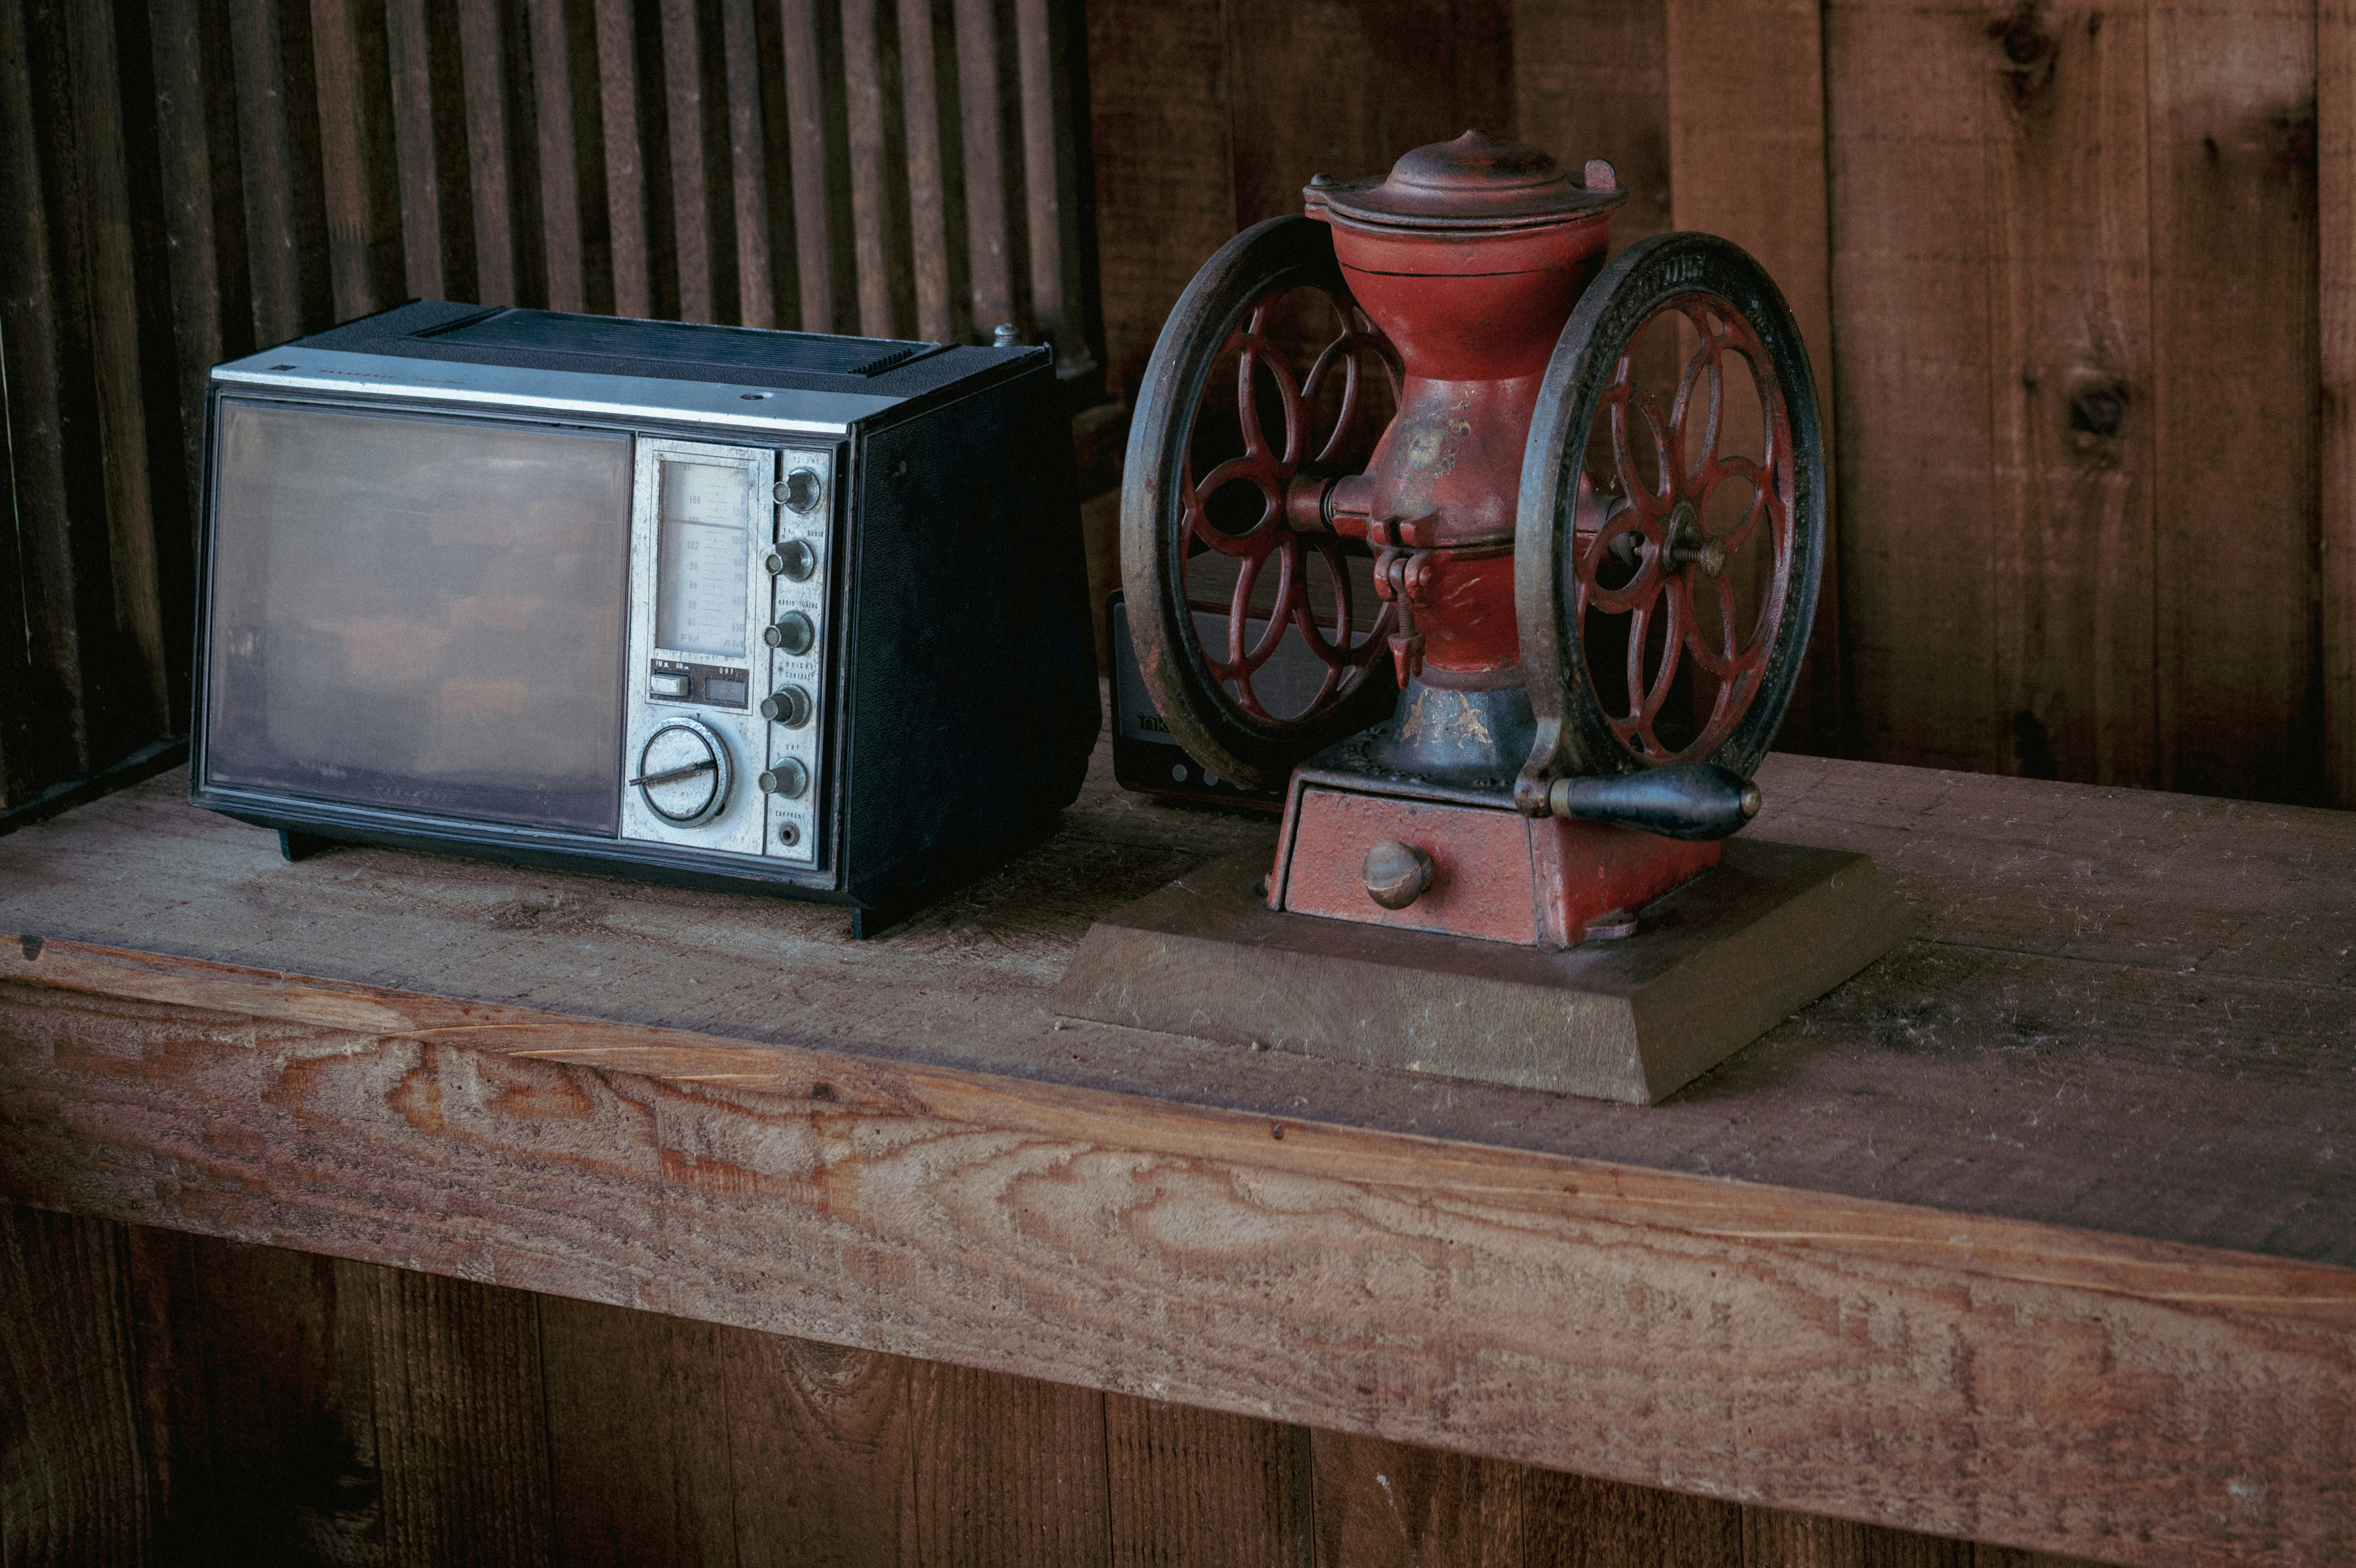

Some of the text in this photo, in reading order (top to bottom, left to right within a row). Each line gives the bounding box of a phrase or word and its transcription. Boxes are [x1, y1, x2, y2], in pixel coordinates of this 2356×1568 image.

[793, 457, 819, 465] VOLUME
[689, 495, 701, 504] 108
[687, 541, 699, 550] 102
[690, 562, 698, 570] 98
[690, 581, 697, 589] 94
[688, 601, 696, 609] 90
[799, 601, 819, 609] TUNING
[688, 618, 696, 627] 87
[732, 624, 744, 632] 530
[681, 634, 699, 643] FM
[723, 639, 744, 648] AM
[786, 662, 813, 670] BRIGHT
[785, 672, 814, 680] CONTRAST
[1136, 712, 1170, 733] ink
[776, 810, 805, 819] EARPHONE
